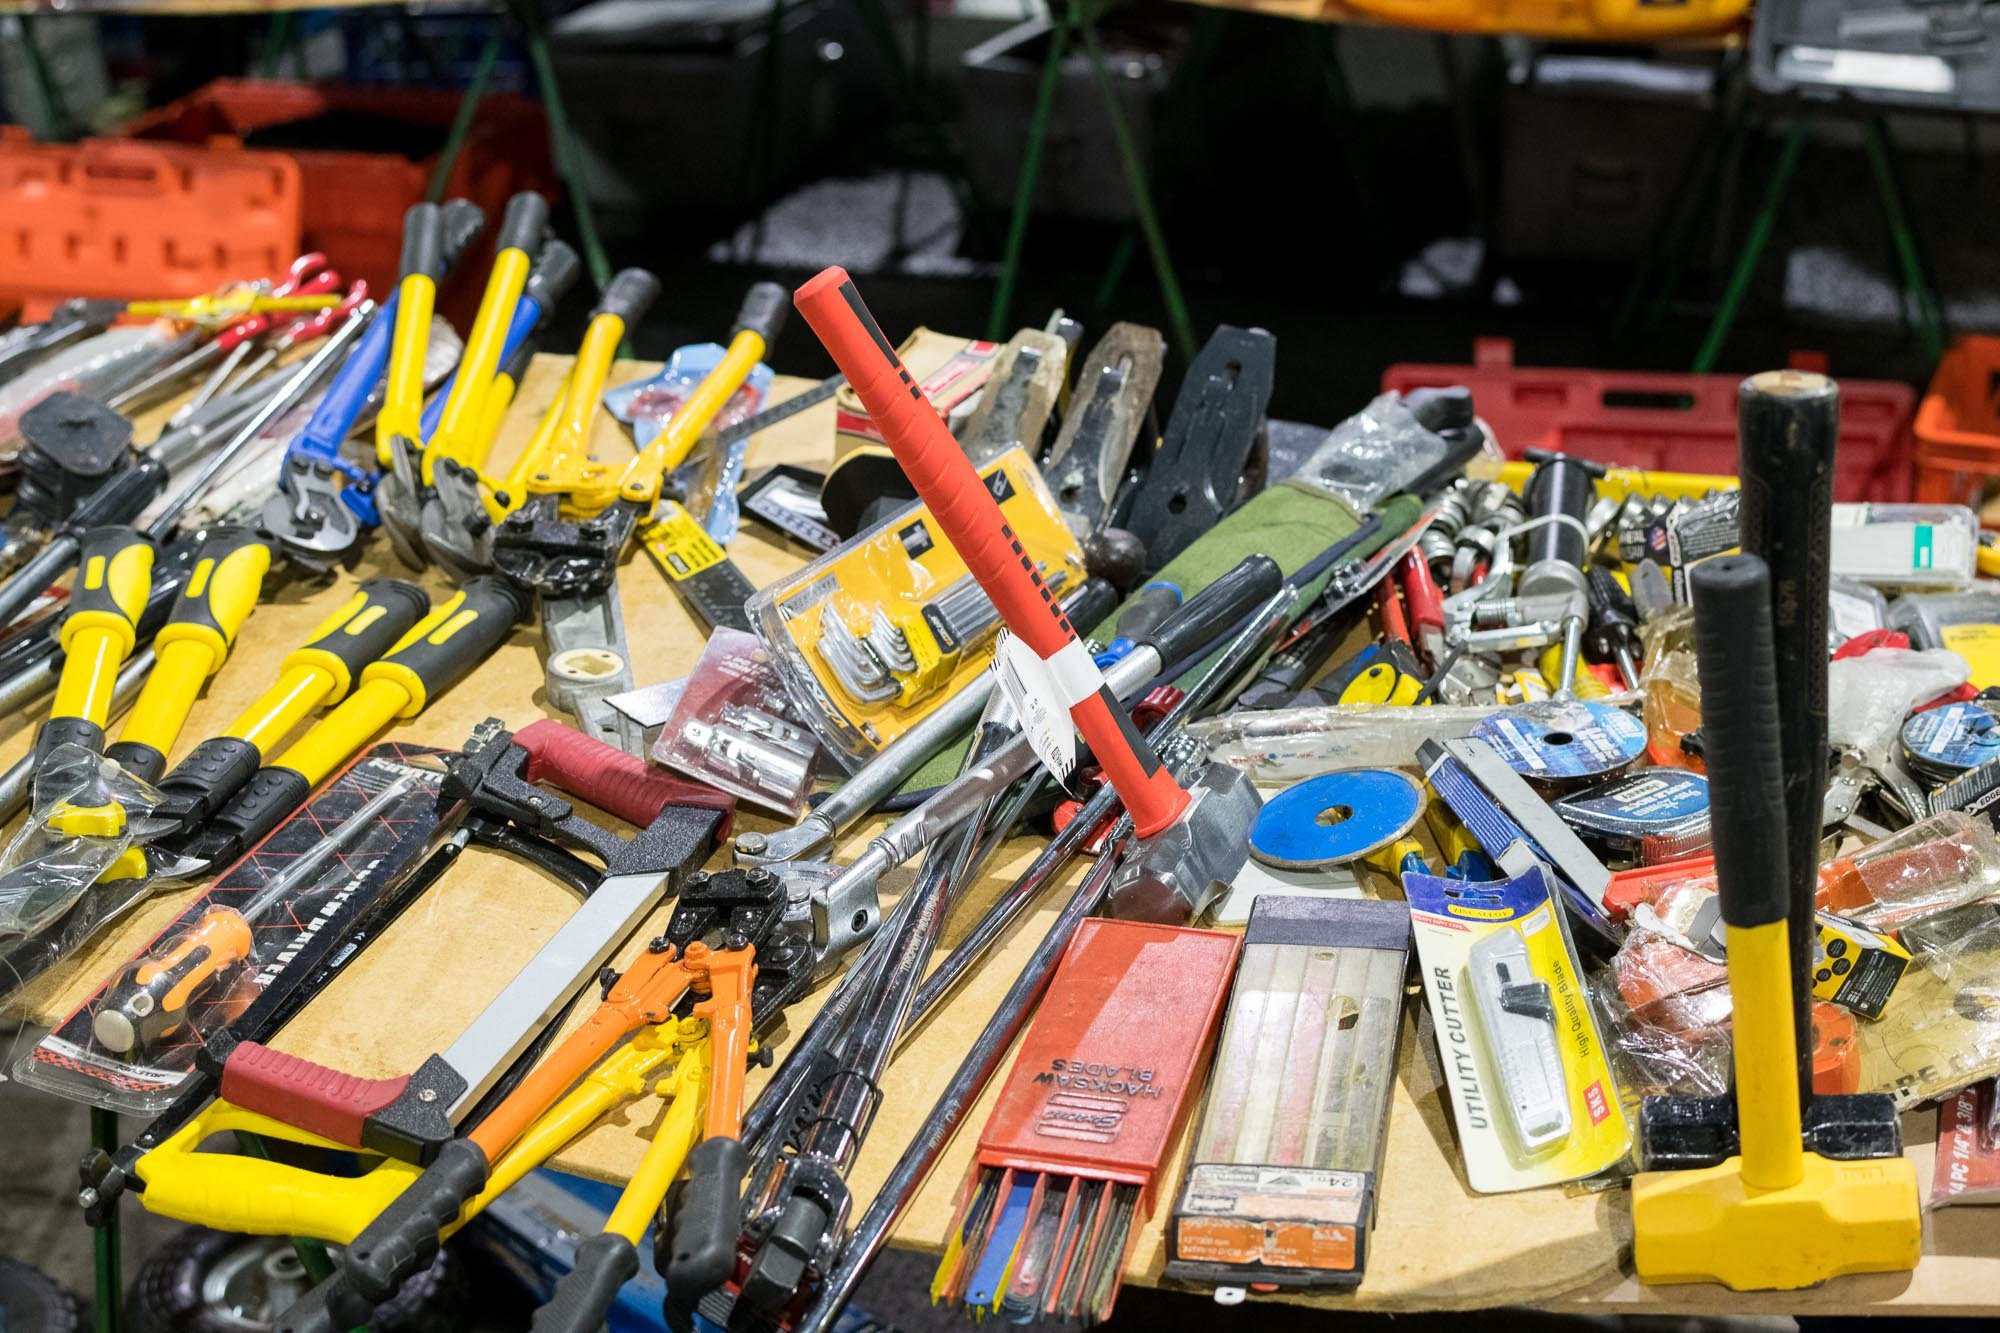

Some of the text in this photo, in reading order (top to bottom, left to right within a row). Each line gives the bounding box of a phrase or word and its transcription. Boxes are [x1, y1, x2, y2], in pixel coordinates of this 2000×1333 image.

[1435, 966, 1466, 1043] CUTTER
[1552, 960, 1590, 1059] High Quality Blade
[1051, 1058, 1155, 1081] BLADES
[1033, 1072, 1162, 1098] HACKSAW
[1453, 1050, 1488, 1129] UTILITY
[1588, 1089, 1604, 1117] SK5
[1956, 1123, 1971, 1136] &
[1951, 1162, 1969, 1182] PC
